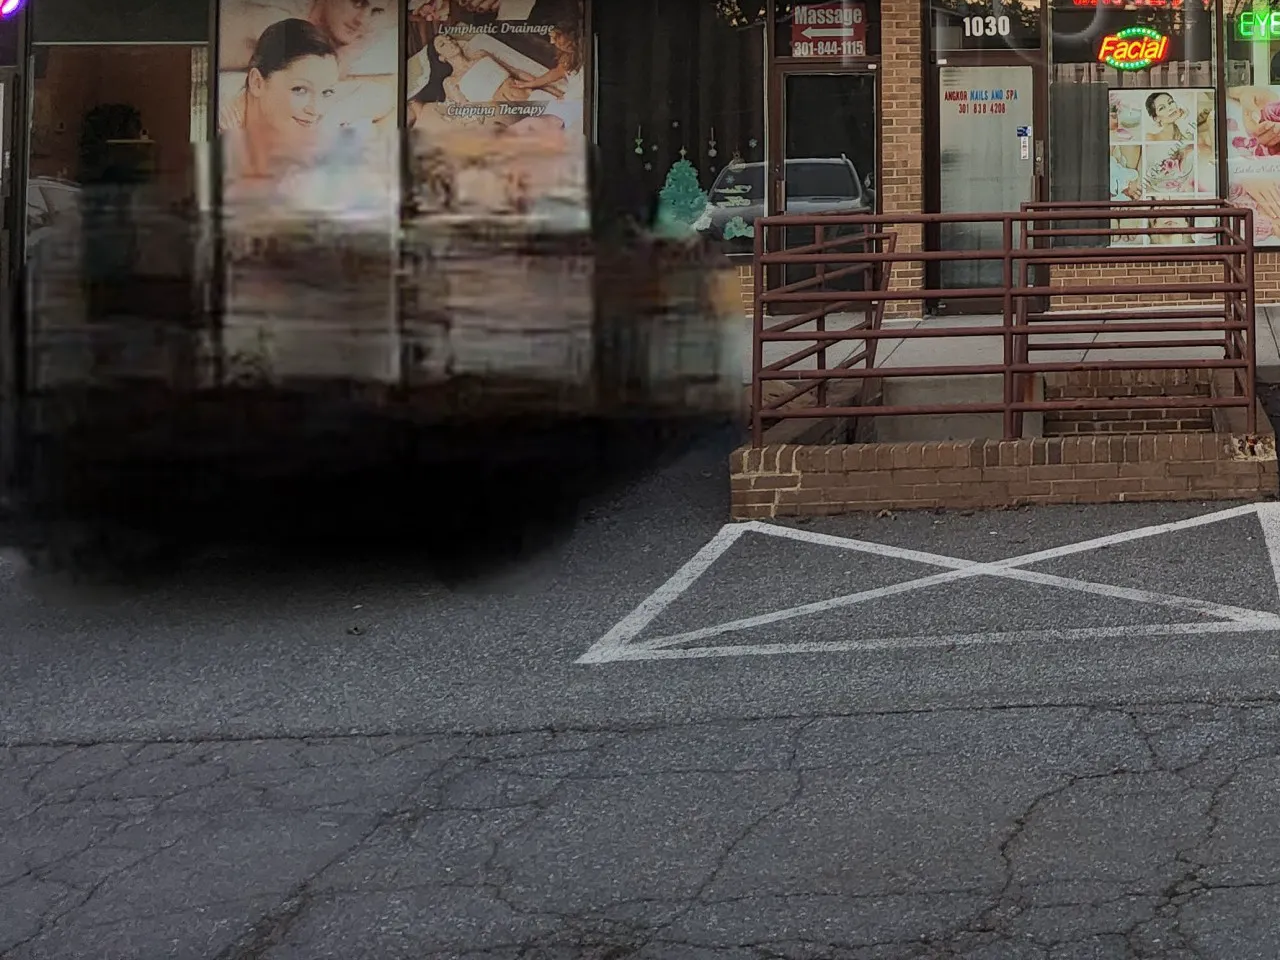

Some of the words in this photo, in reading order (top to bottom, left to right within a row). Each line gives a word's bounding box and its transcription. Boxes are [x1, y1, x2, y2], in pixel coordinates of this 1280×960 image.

[794, 5, 862, 26] Massage
[438, 22, 498, 36] Lymphatic
[500, 22, 556, 36] Drainage
[962, 15, 1011, 37] 1030
[794, 41, 864, 56] 301-844-1115
[1098, 36, 1168, 60] Facial
[944, 90, 968, 101] ANGKOR
[970, 89, 989, 101] NAILS
[991, 89, 1004, 100] AND
[1005, 89, 1018, 100] SPA
[447, 104, 496, 118] Cupping
[499, 104, 546, 118] Therapy
[959, 103, 969, 114] 301
